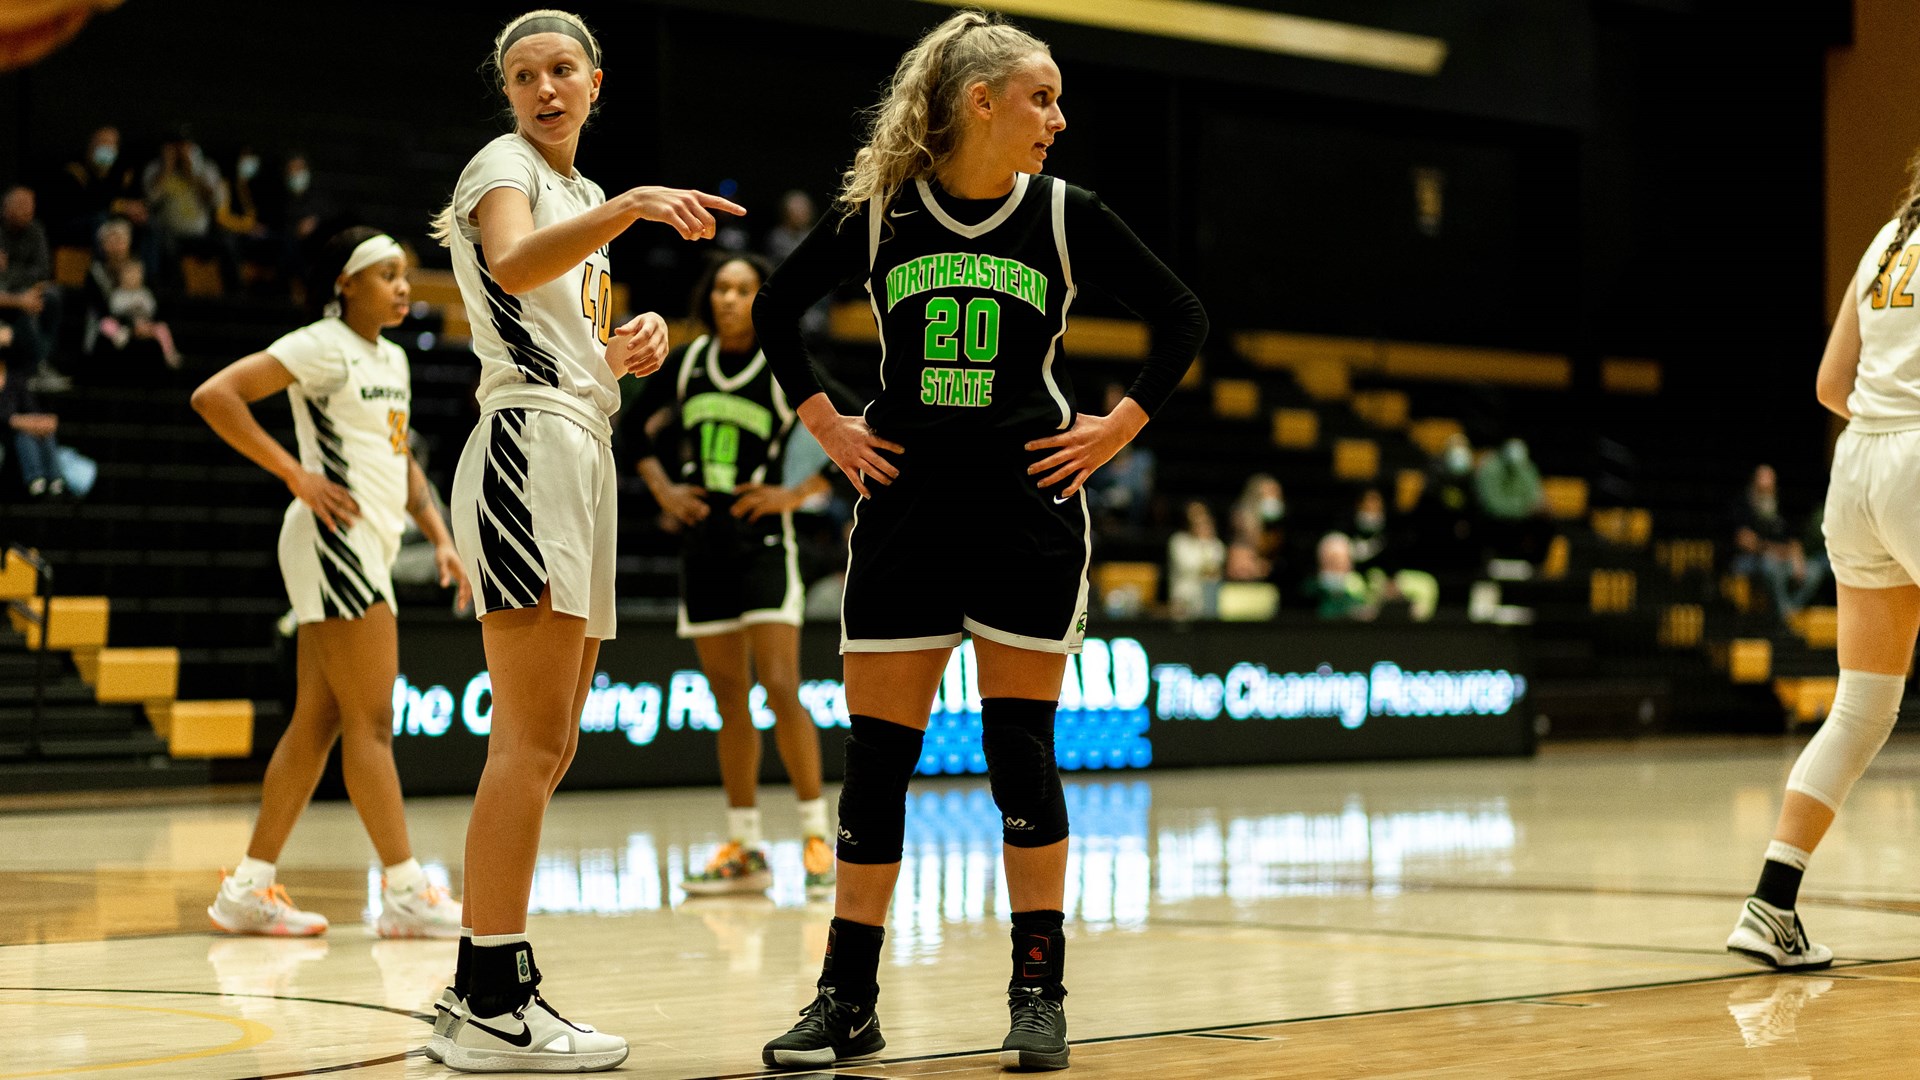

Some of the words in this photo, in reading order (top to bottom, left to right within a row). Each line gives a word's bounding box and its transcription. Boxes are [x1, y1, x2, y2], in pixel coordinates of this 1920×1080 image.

[581, 261, 612, 346] 40
[886, 252, 1048, 316] NORTHEASTERN
[924, 297, 1000, 362] 20
[921, 367, 995, 407] STATE
[392, 673, 455, 737] he
[1151, 663, 1225, 720] The
[1224, 662, 1369, 729] Cleaning
